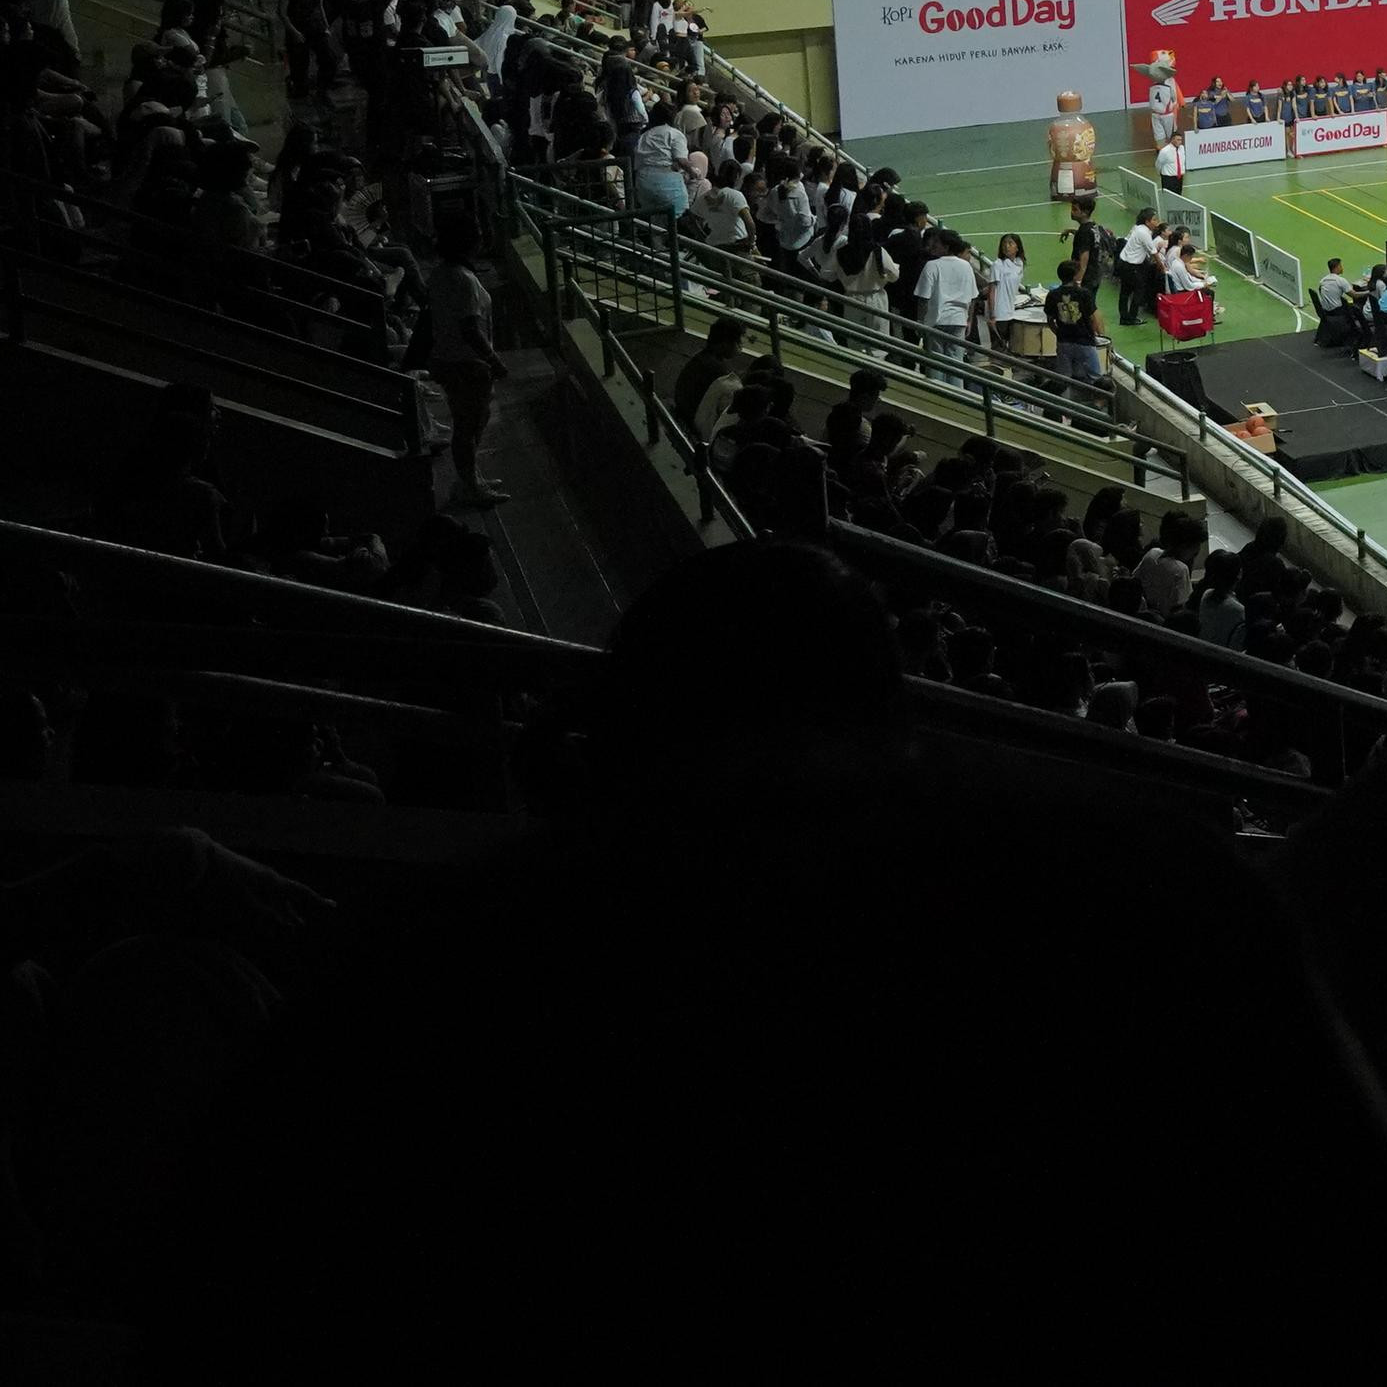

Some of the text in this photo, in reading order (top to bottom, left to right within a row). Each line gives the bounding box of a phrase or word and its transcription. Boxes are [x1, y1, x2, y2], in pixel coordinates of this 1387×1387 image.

[894, 54, 935, 66] KARENA
[938, 51, 966, 63] HIDUP
[969, 48, 998, 60] PERLU
[1042, 42, 1064, 52] RASA
[1314, 126, 1351, 142] Good
[1352, 122, 1381, 140] Day
[1198, 135, 1273, 156] MAINBASKET.COM
